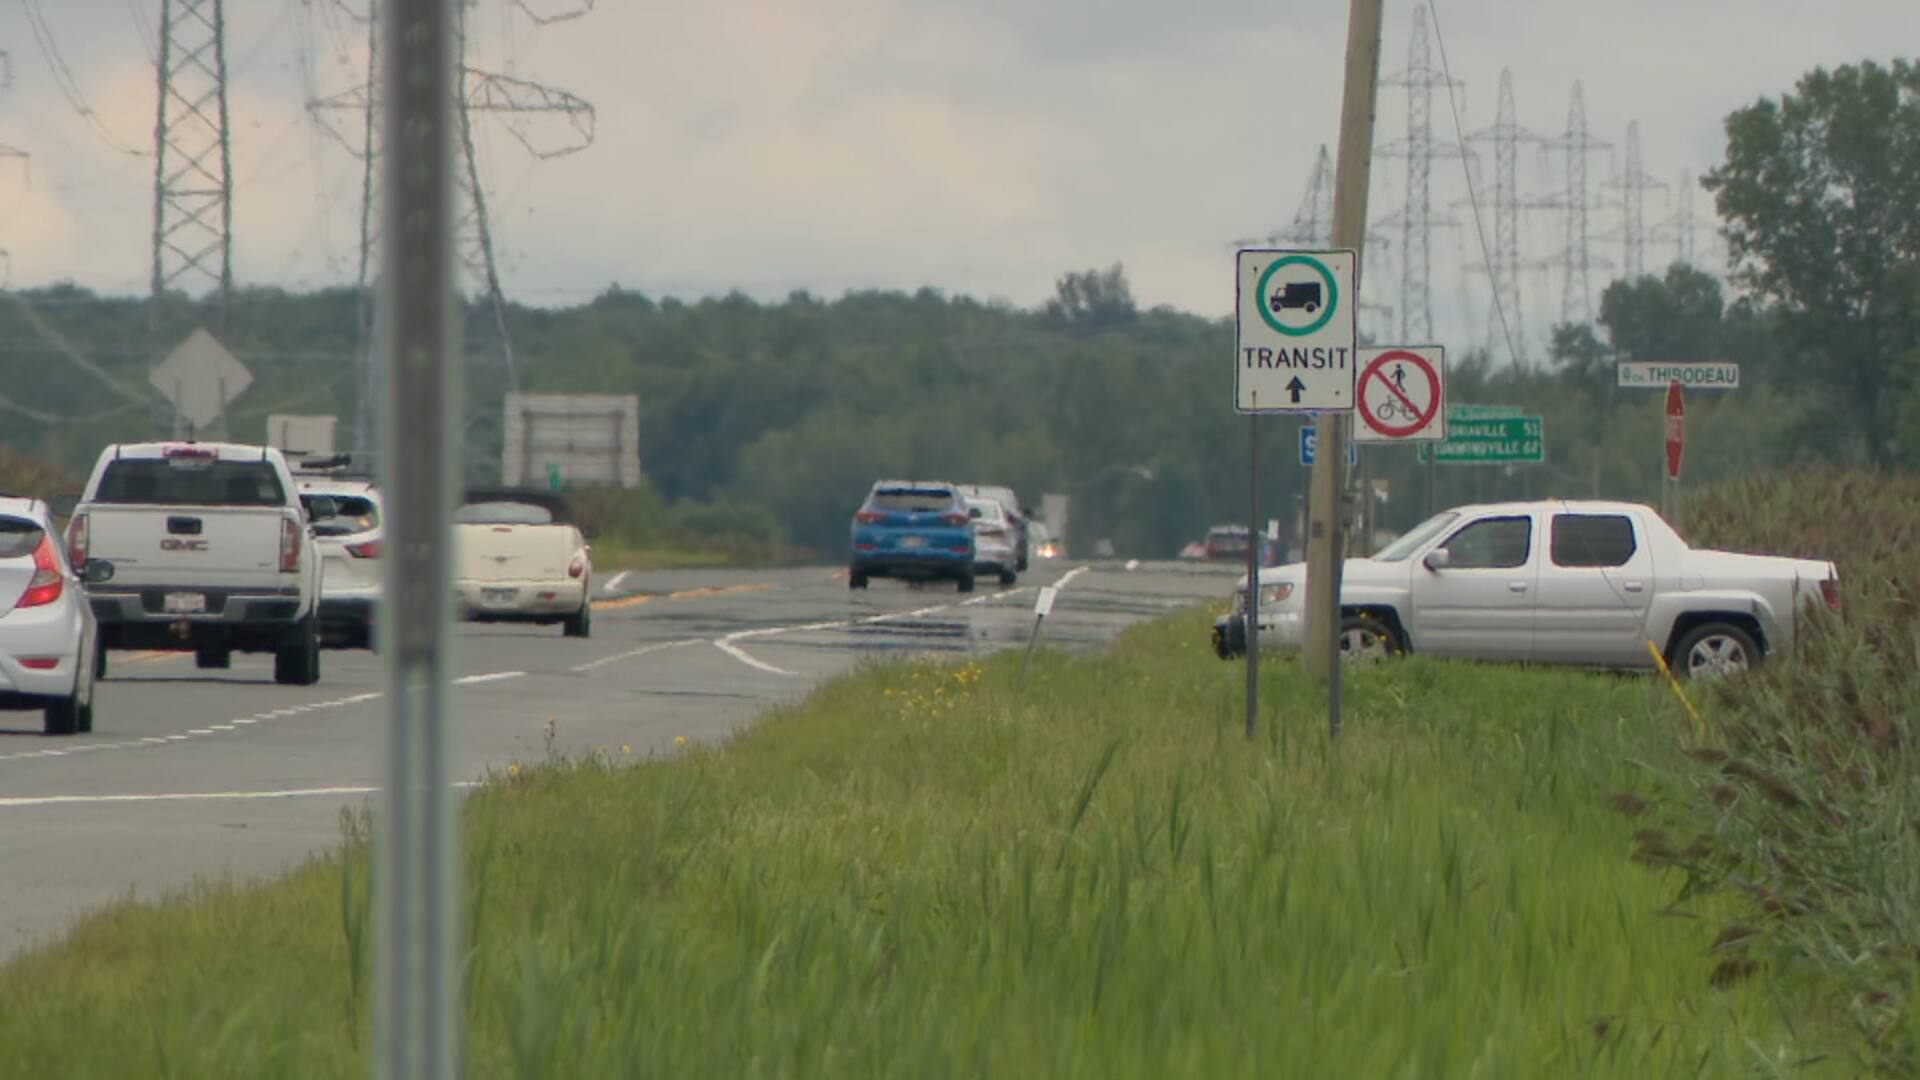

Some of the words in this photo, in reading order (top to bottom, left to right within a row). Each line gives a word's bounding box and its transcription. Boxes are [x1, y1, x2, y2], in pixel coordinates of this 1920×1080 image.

[1243, 347, 1349, 369] TRANSIT
[1647, 366, 1737, 383] THIBODEAU
[160, 539, 208, 551] GMC
